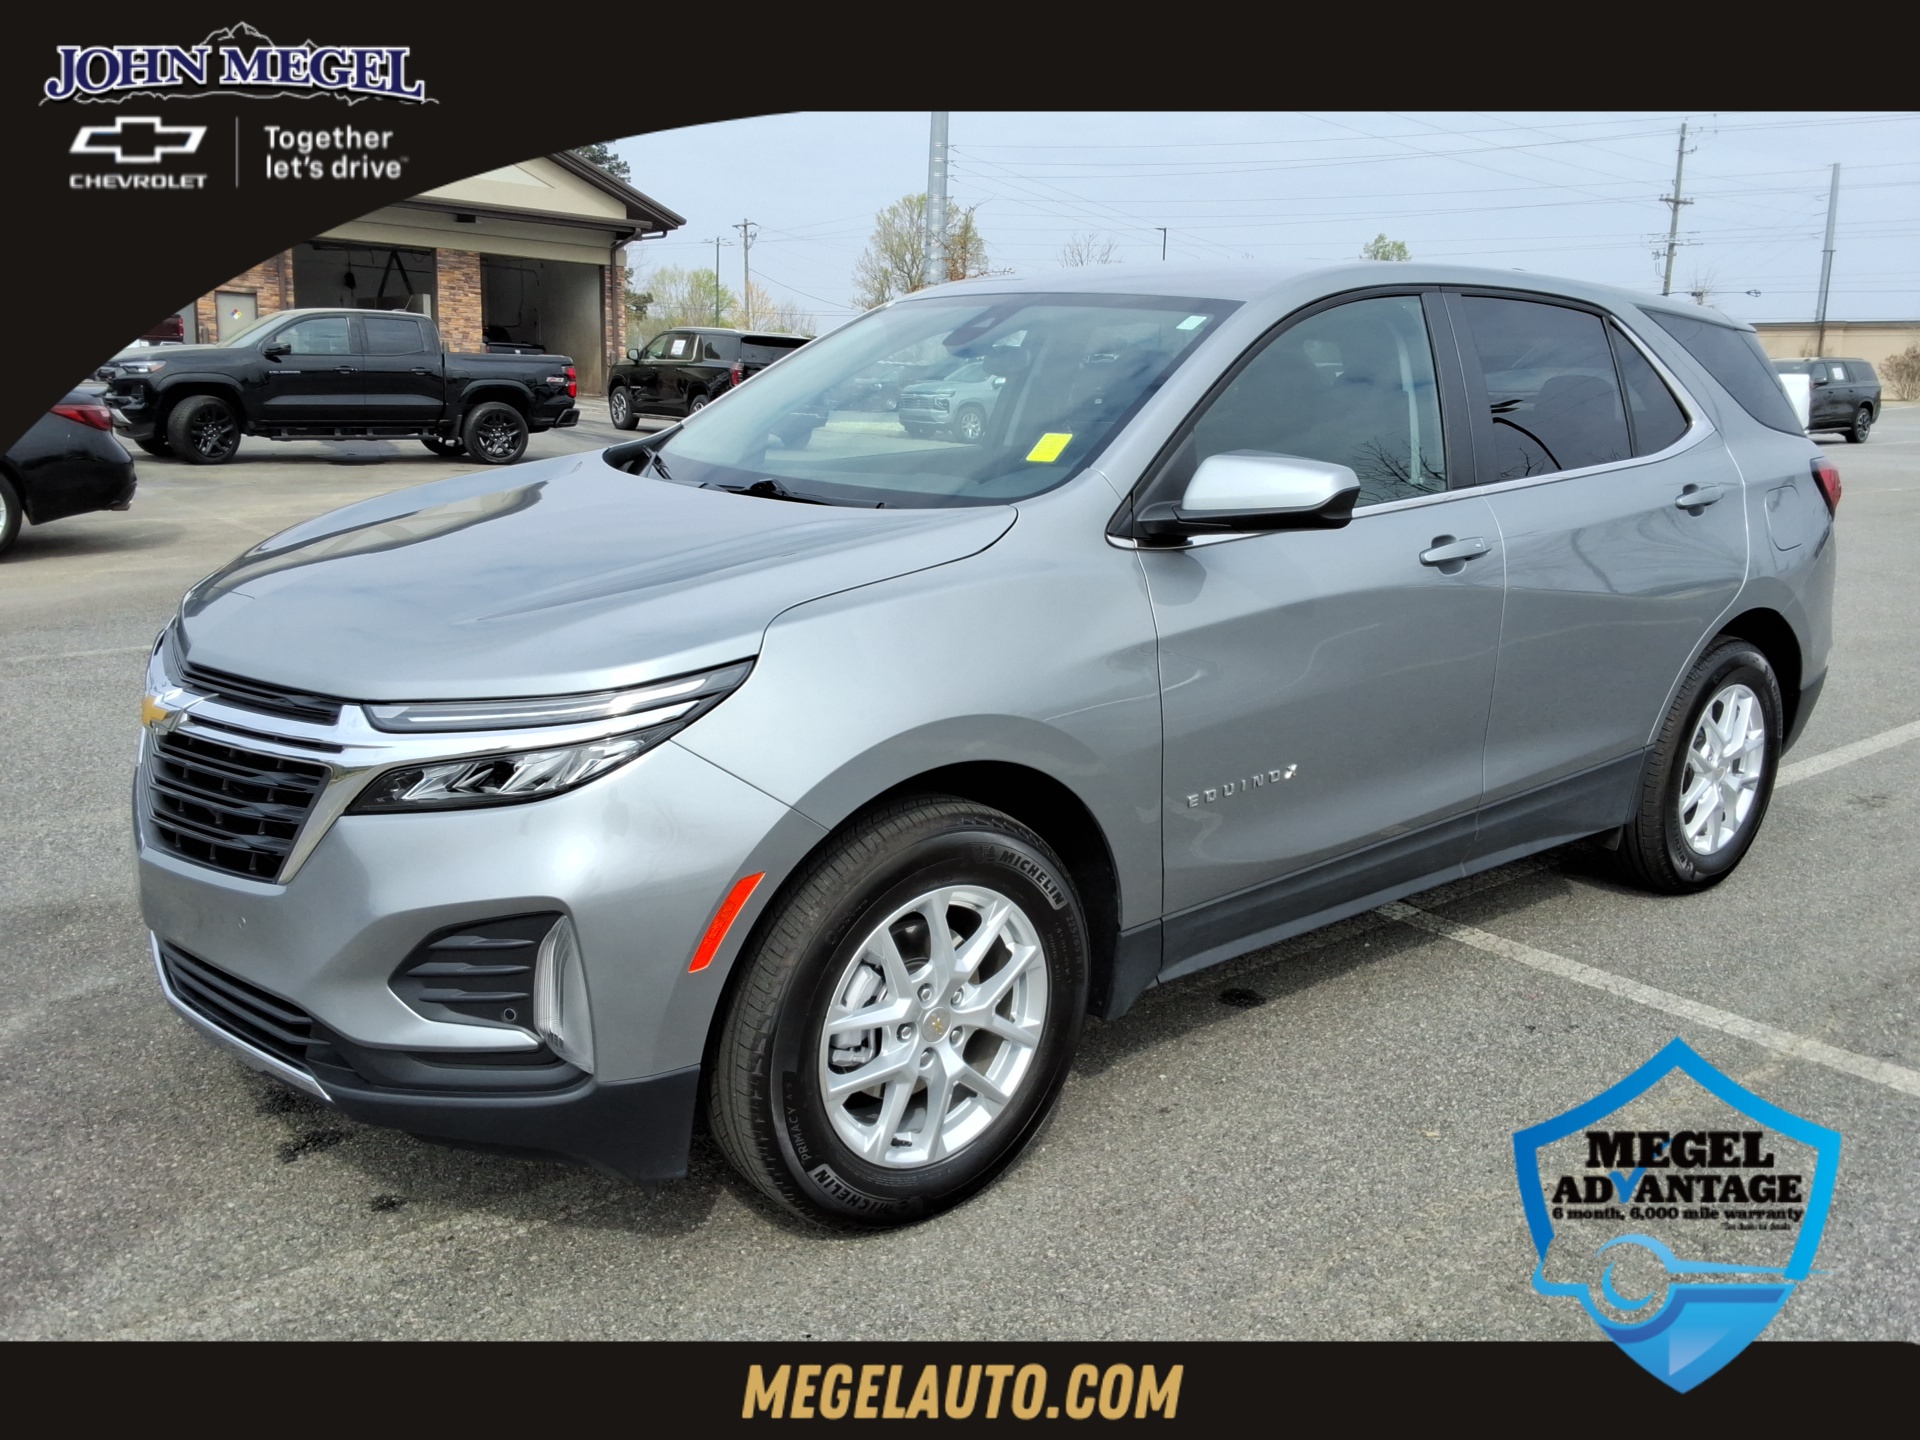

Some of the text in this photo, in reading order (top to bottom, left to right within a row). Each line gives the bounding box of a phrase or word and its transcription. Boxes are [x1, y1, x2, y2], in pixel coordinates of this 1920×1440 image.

[1187, 763, 1298, 808] EQUINOX
[1000, 850, 1065, 905] MICHELIN
[786, 1106, 812, 1161] PRIMACY
[814, 1168, 891, 1213] MICHELIN
